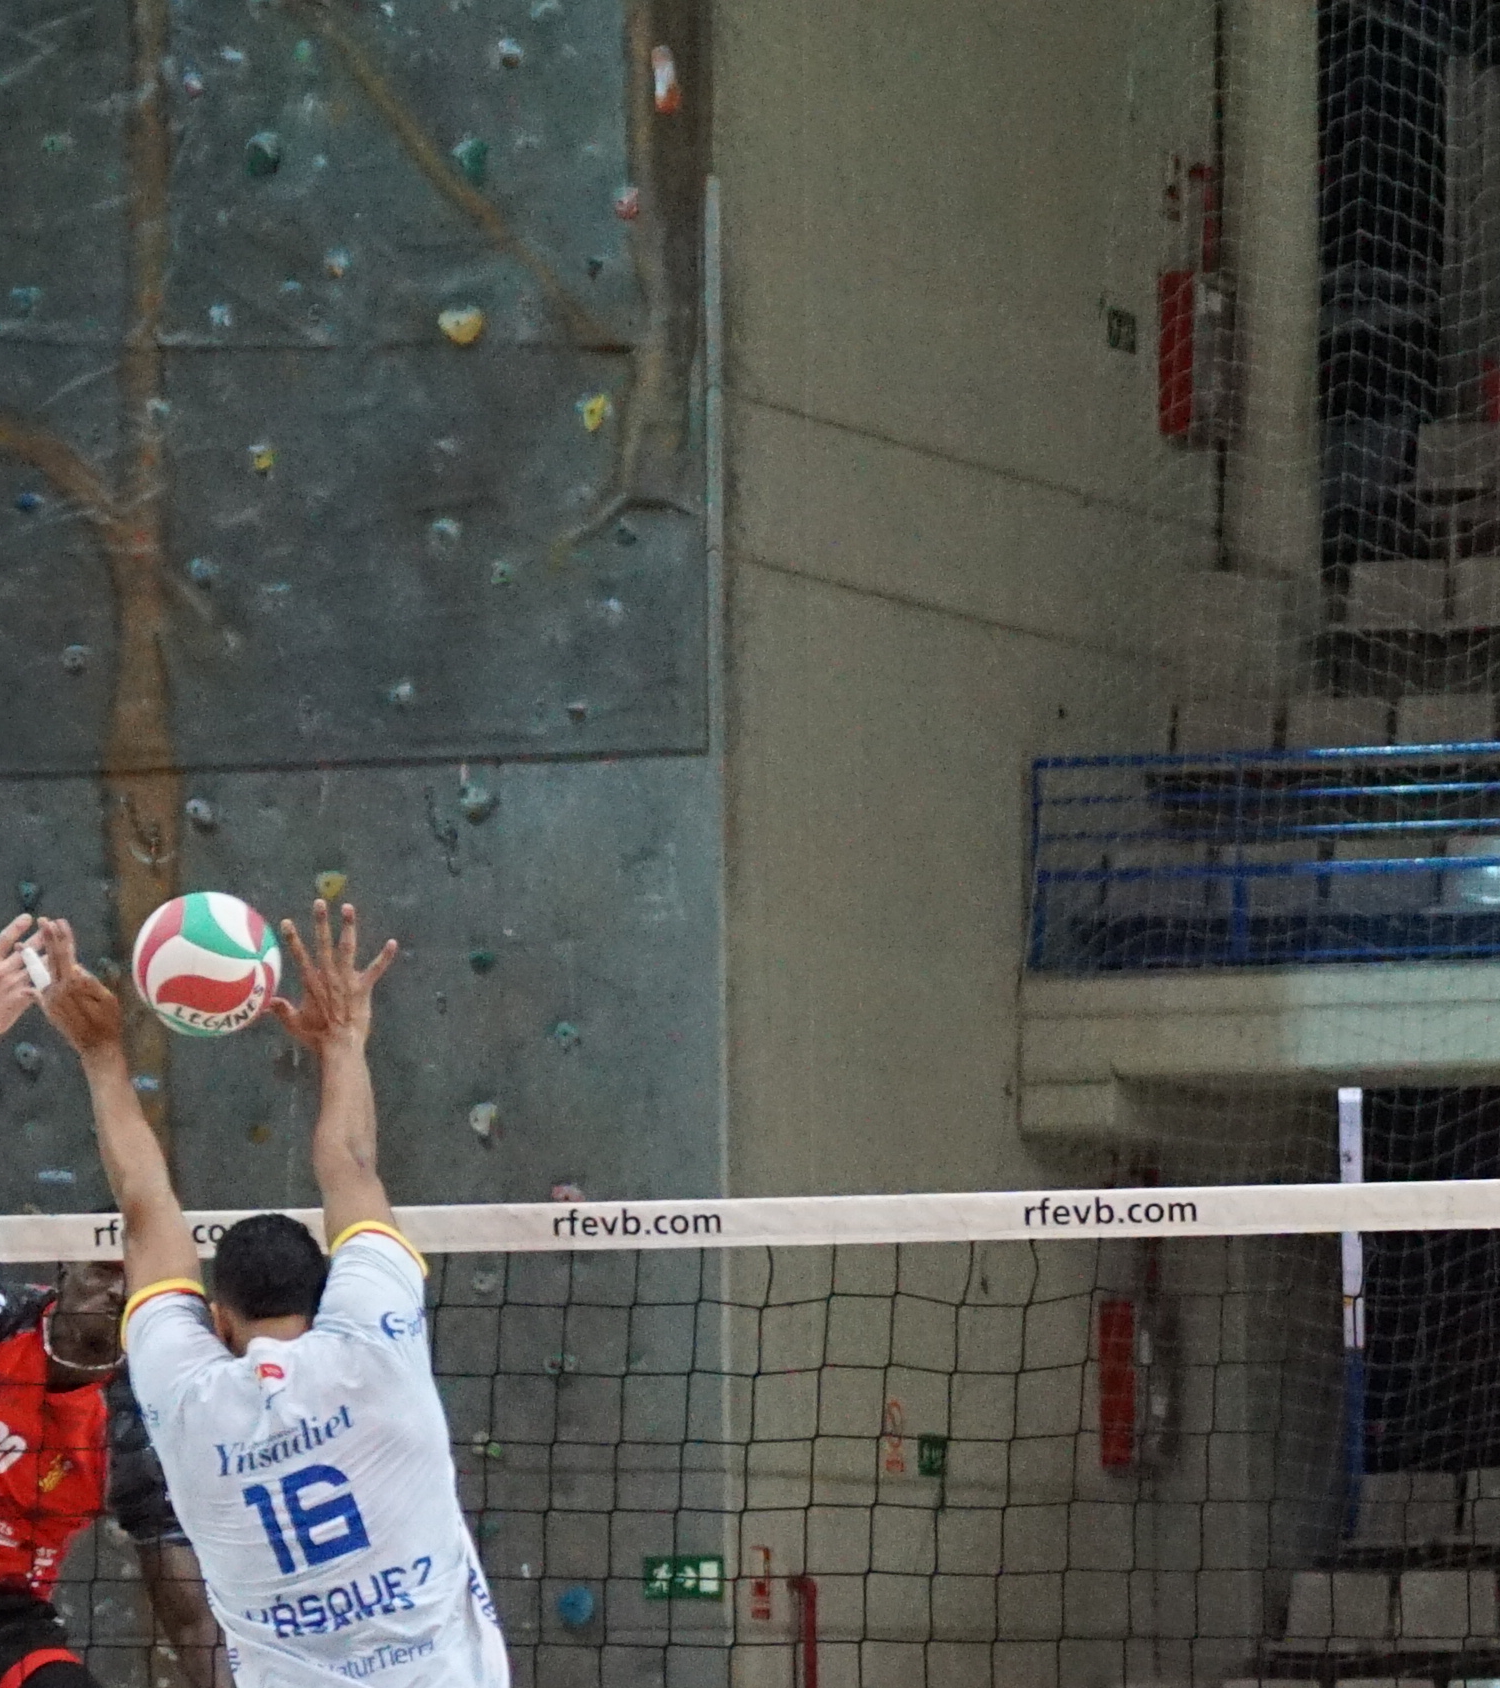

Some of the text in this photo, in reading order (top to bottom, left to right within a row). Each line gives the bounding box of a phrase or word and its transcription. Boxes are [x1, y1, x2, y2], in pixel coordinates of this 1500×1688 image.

[553, 1208, 722, 1237] rfevb.com
[1024, 1196, 1197, 1226] rfevb.com
[214, 1405, 354, 1476] Ynsadiet
[242, 1464, 371, 1575] 16
